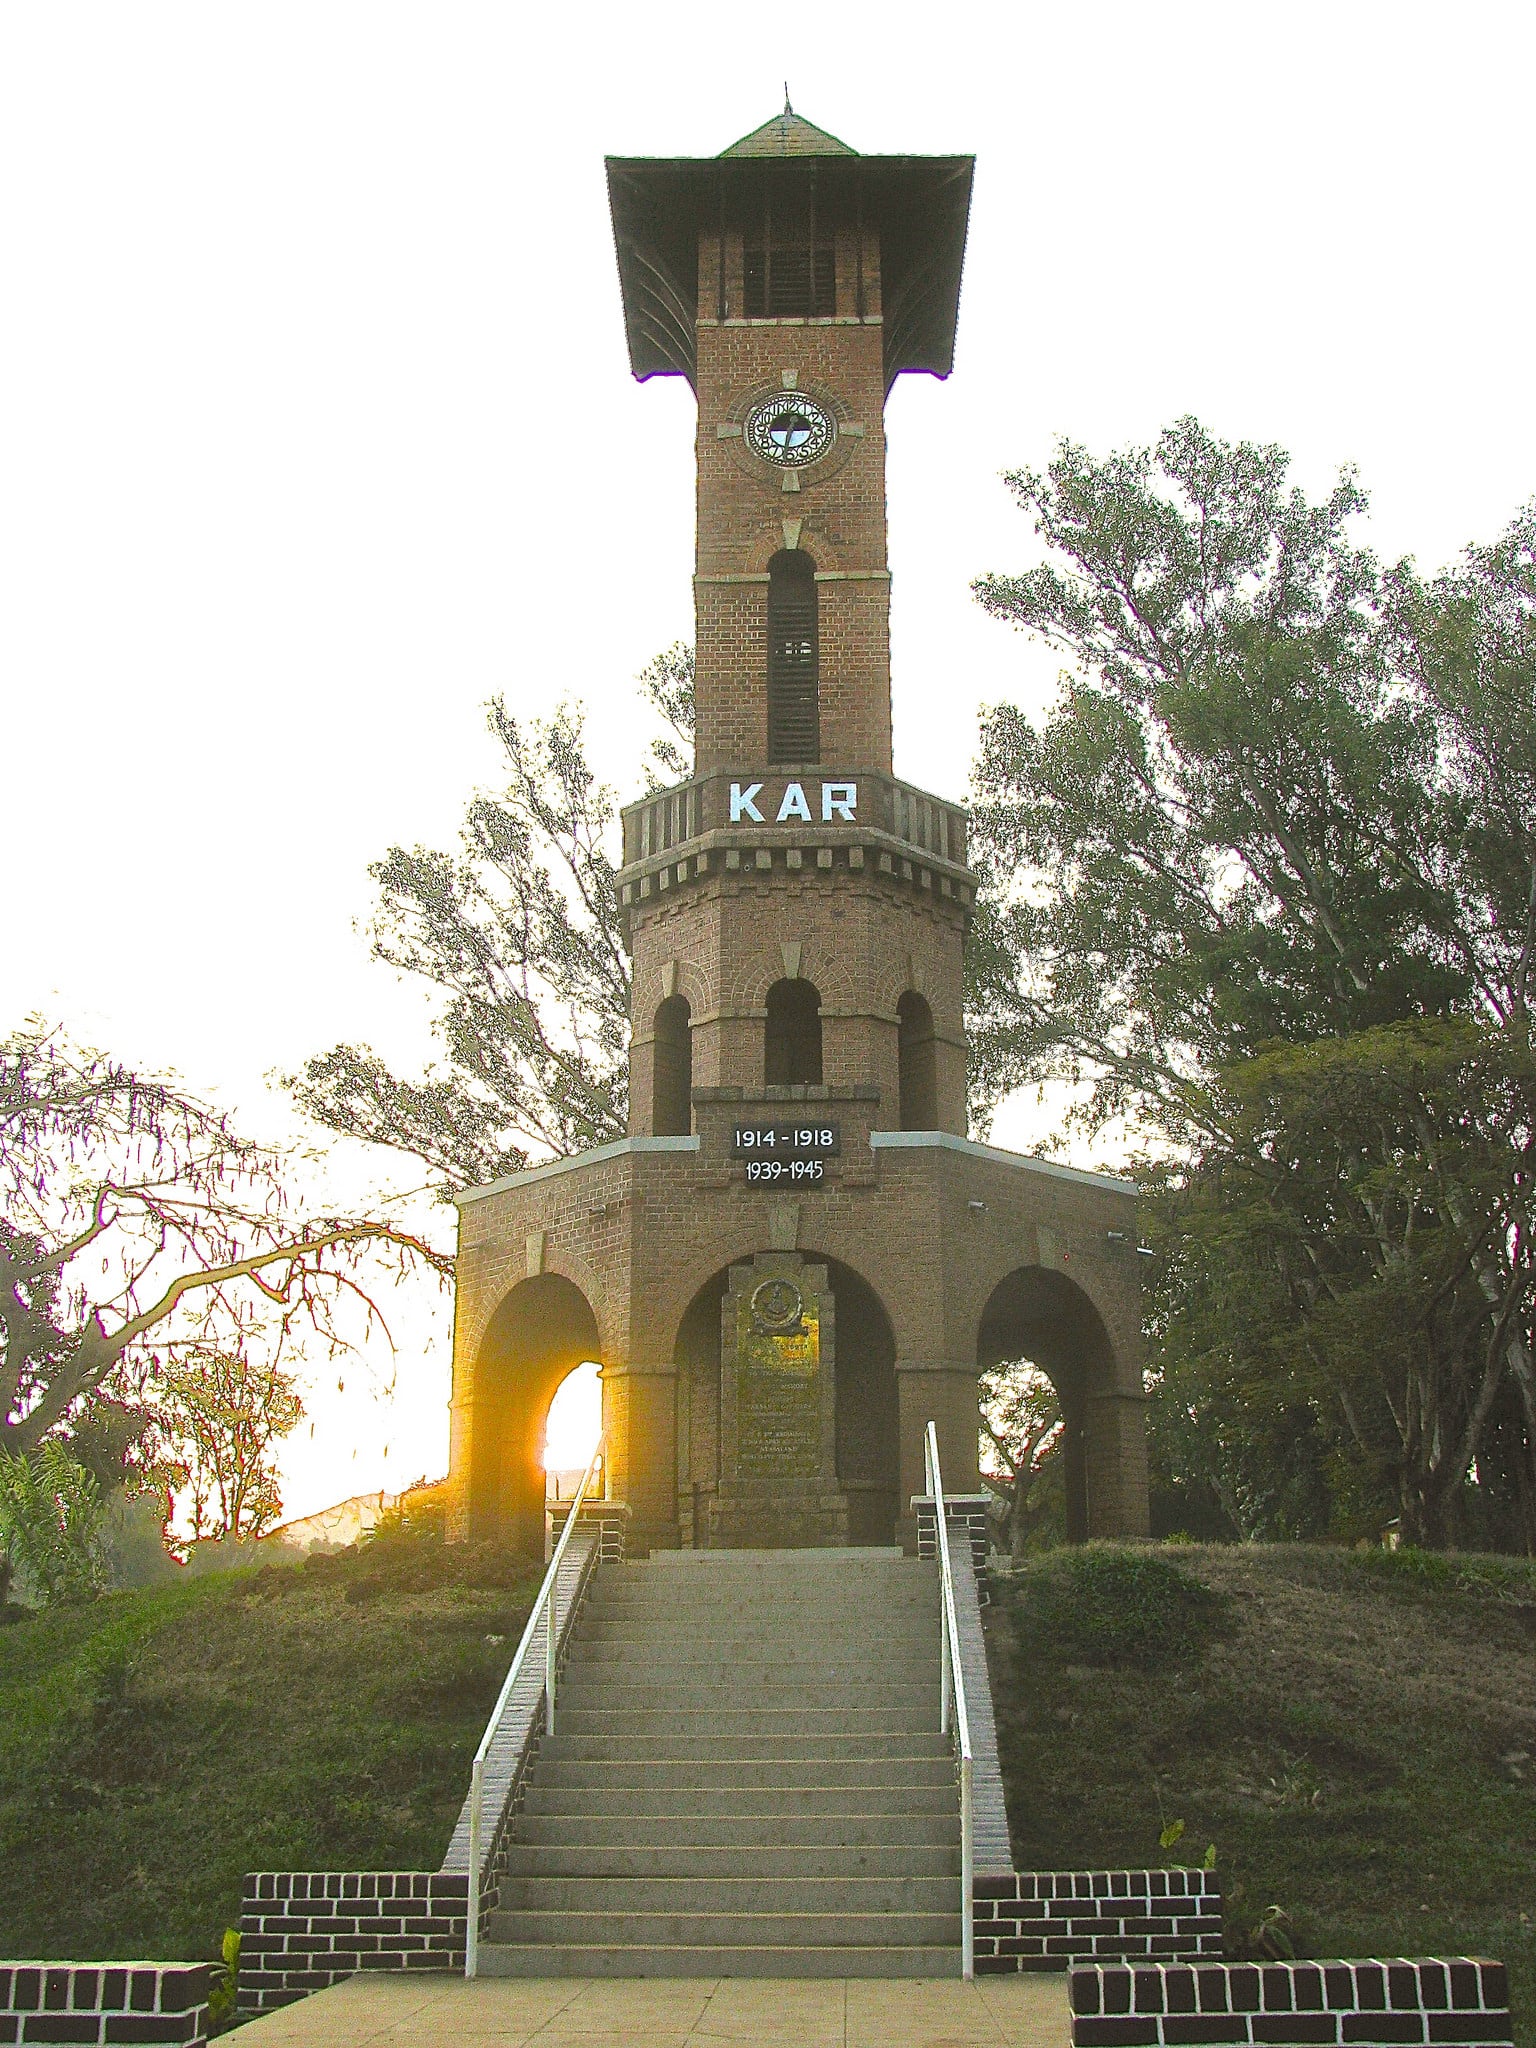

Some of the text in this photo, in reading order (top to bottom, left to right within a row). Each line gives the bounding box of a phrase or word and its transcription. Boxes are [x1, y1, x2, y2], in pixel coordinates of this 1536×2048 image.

[730, 782, 858, 823] KAR
[736, 1130, 776, 1147] 1914
[794, 1129, 834, 1146] 1918
[746, 1160, 823, 1180] 1939-1945
